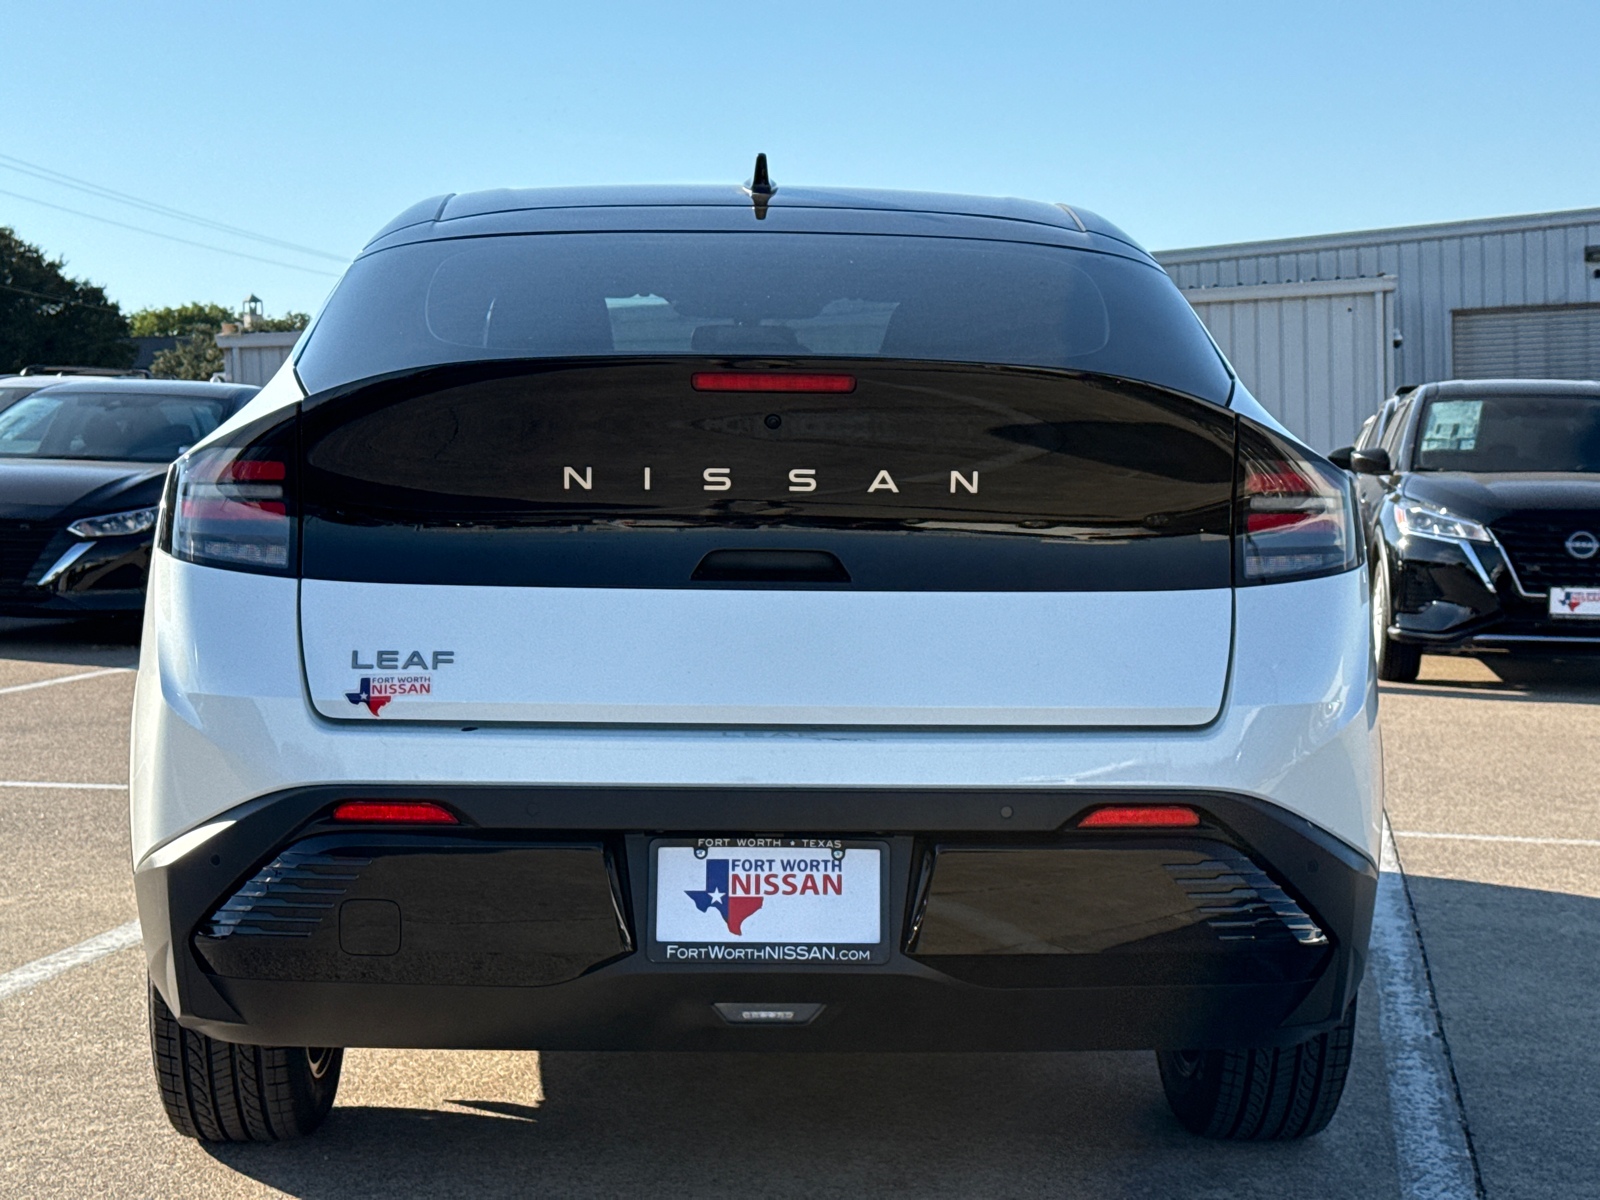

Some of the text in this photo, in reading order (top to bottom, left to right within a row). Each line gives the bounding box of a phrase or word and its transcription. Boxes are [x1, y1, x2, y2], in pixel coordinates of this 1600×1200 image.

[563, 466, 979, 494] NISSAN
[351, 650, 455, 670] LEAF
[371, 683, 431, 695] NISSAN
[698, 838, 842, 848] FORT WORTH TEXAS
[731, 859, 842, 873] FORT WORTH
[731, 873, 843, 896] NISSAN
